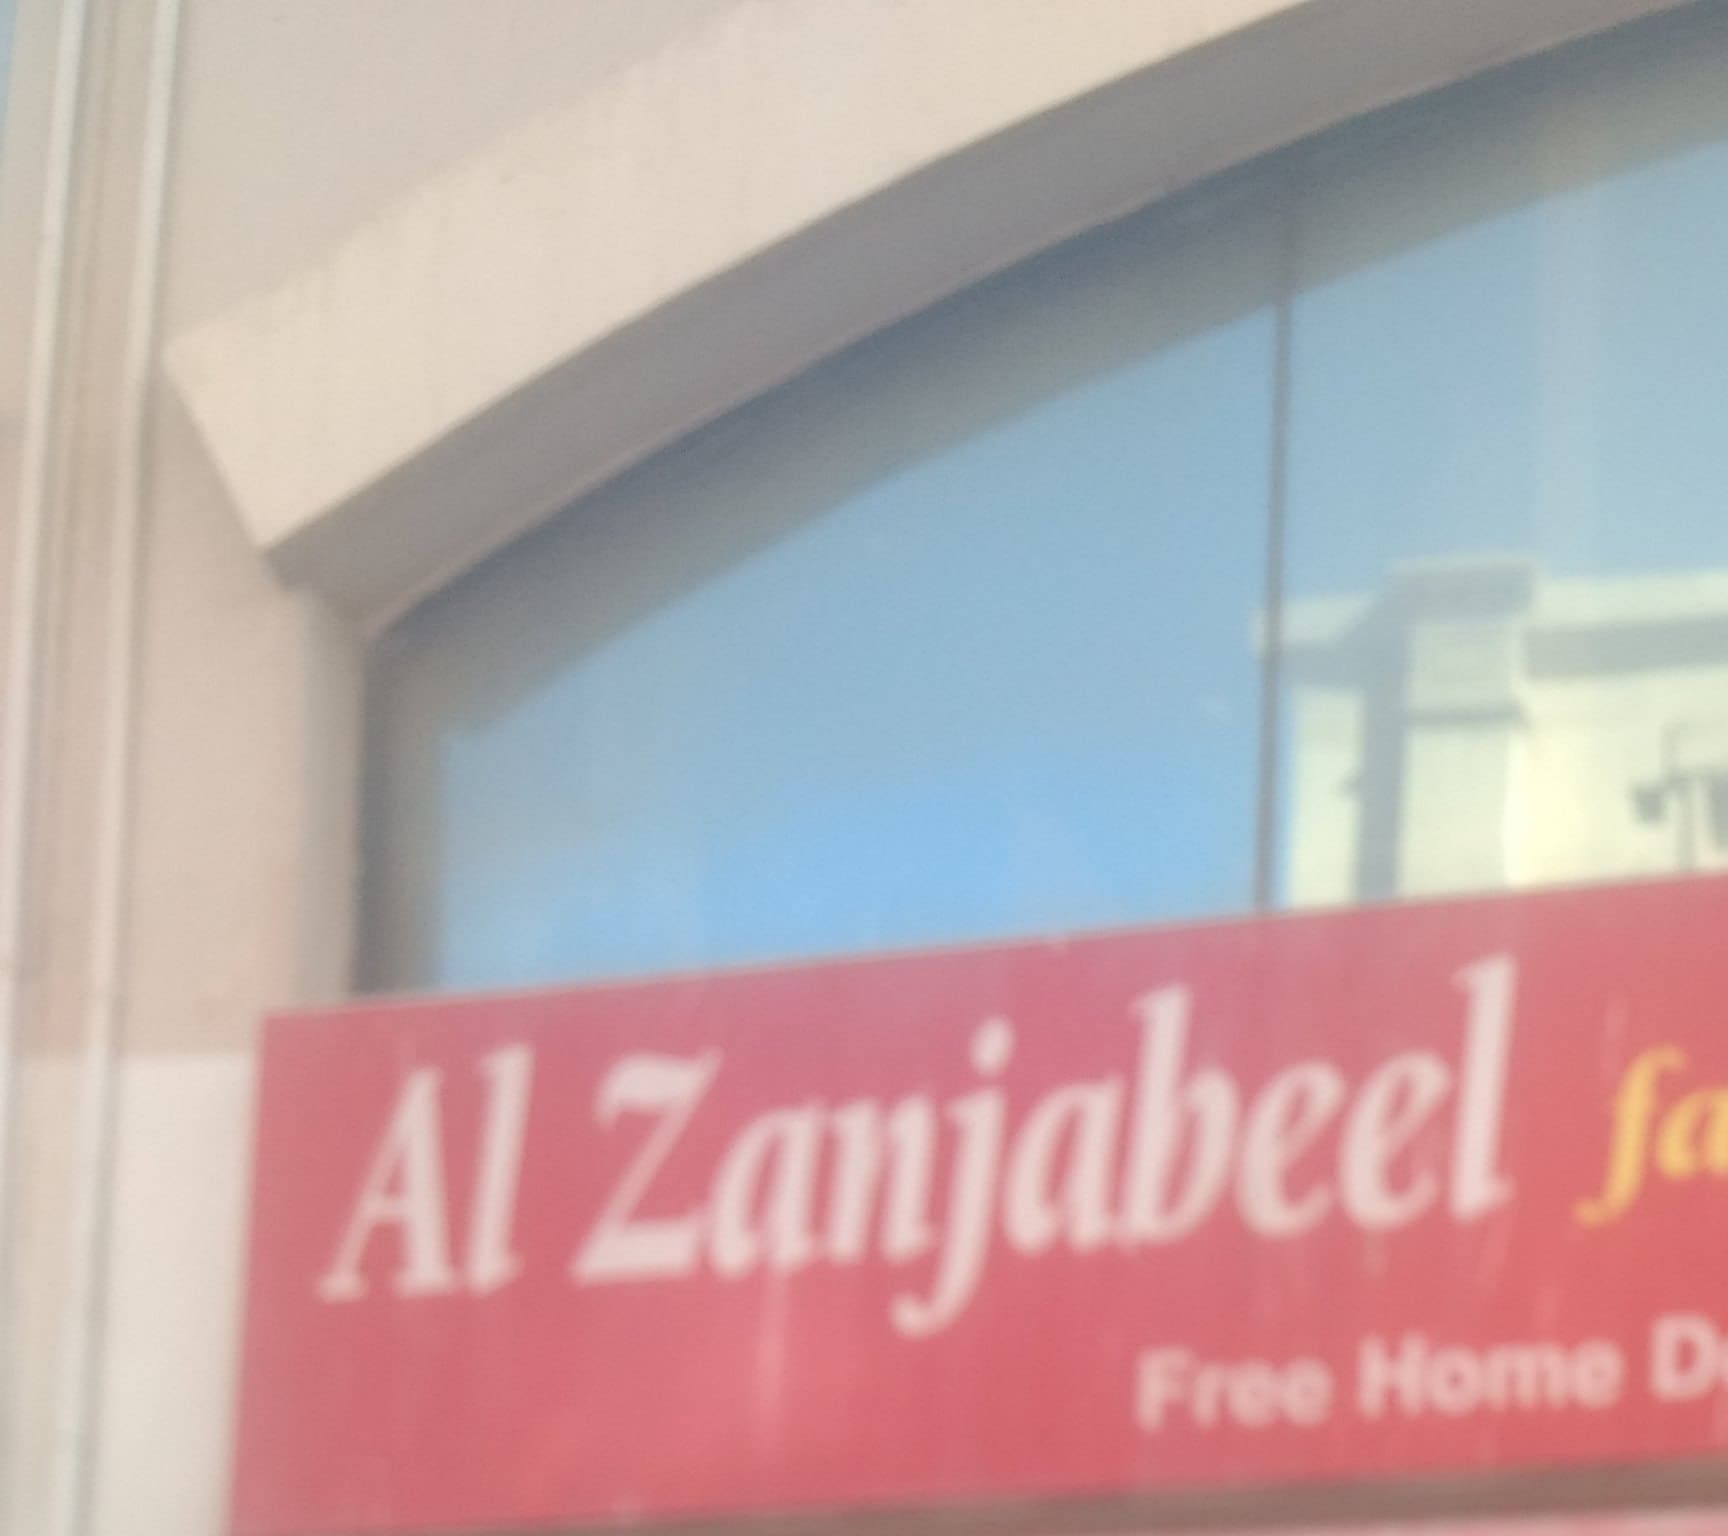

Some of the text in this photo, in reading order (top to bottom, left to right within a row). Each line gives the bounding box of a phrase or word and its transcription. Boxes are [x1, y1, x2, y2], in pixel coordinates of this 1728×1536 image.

[318, 953, 1517, 1337] Al Zanjabeel
[1134, 1348, 1333, 1432] Free
[1357, 1334, 1622, 1418] Home
